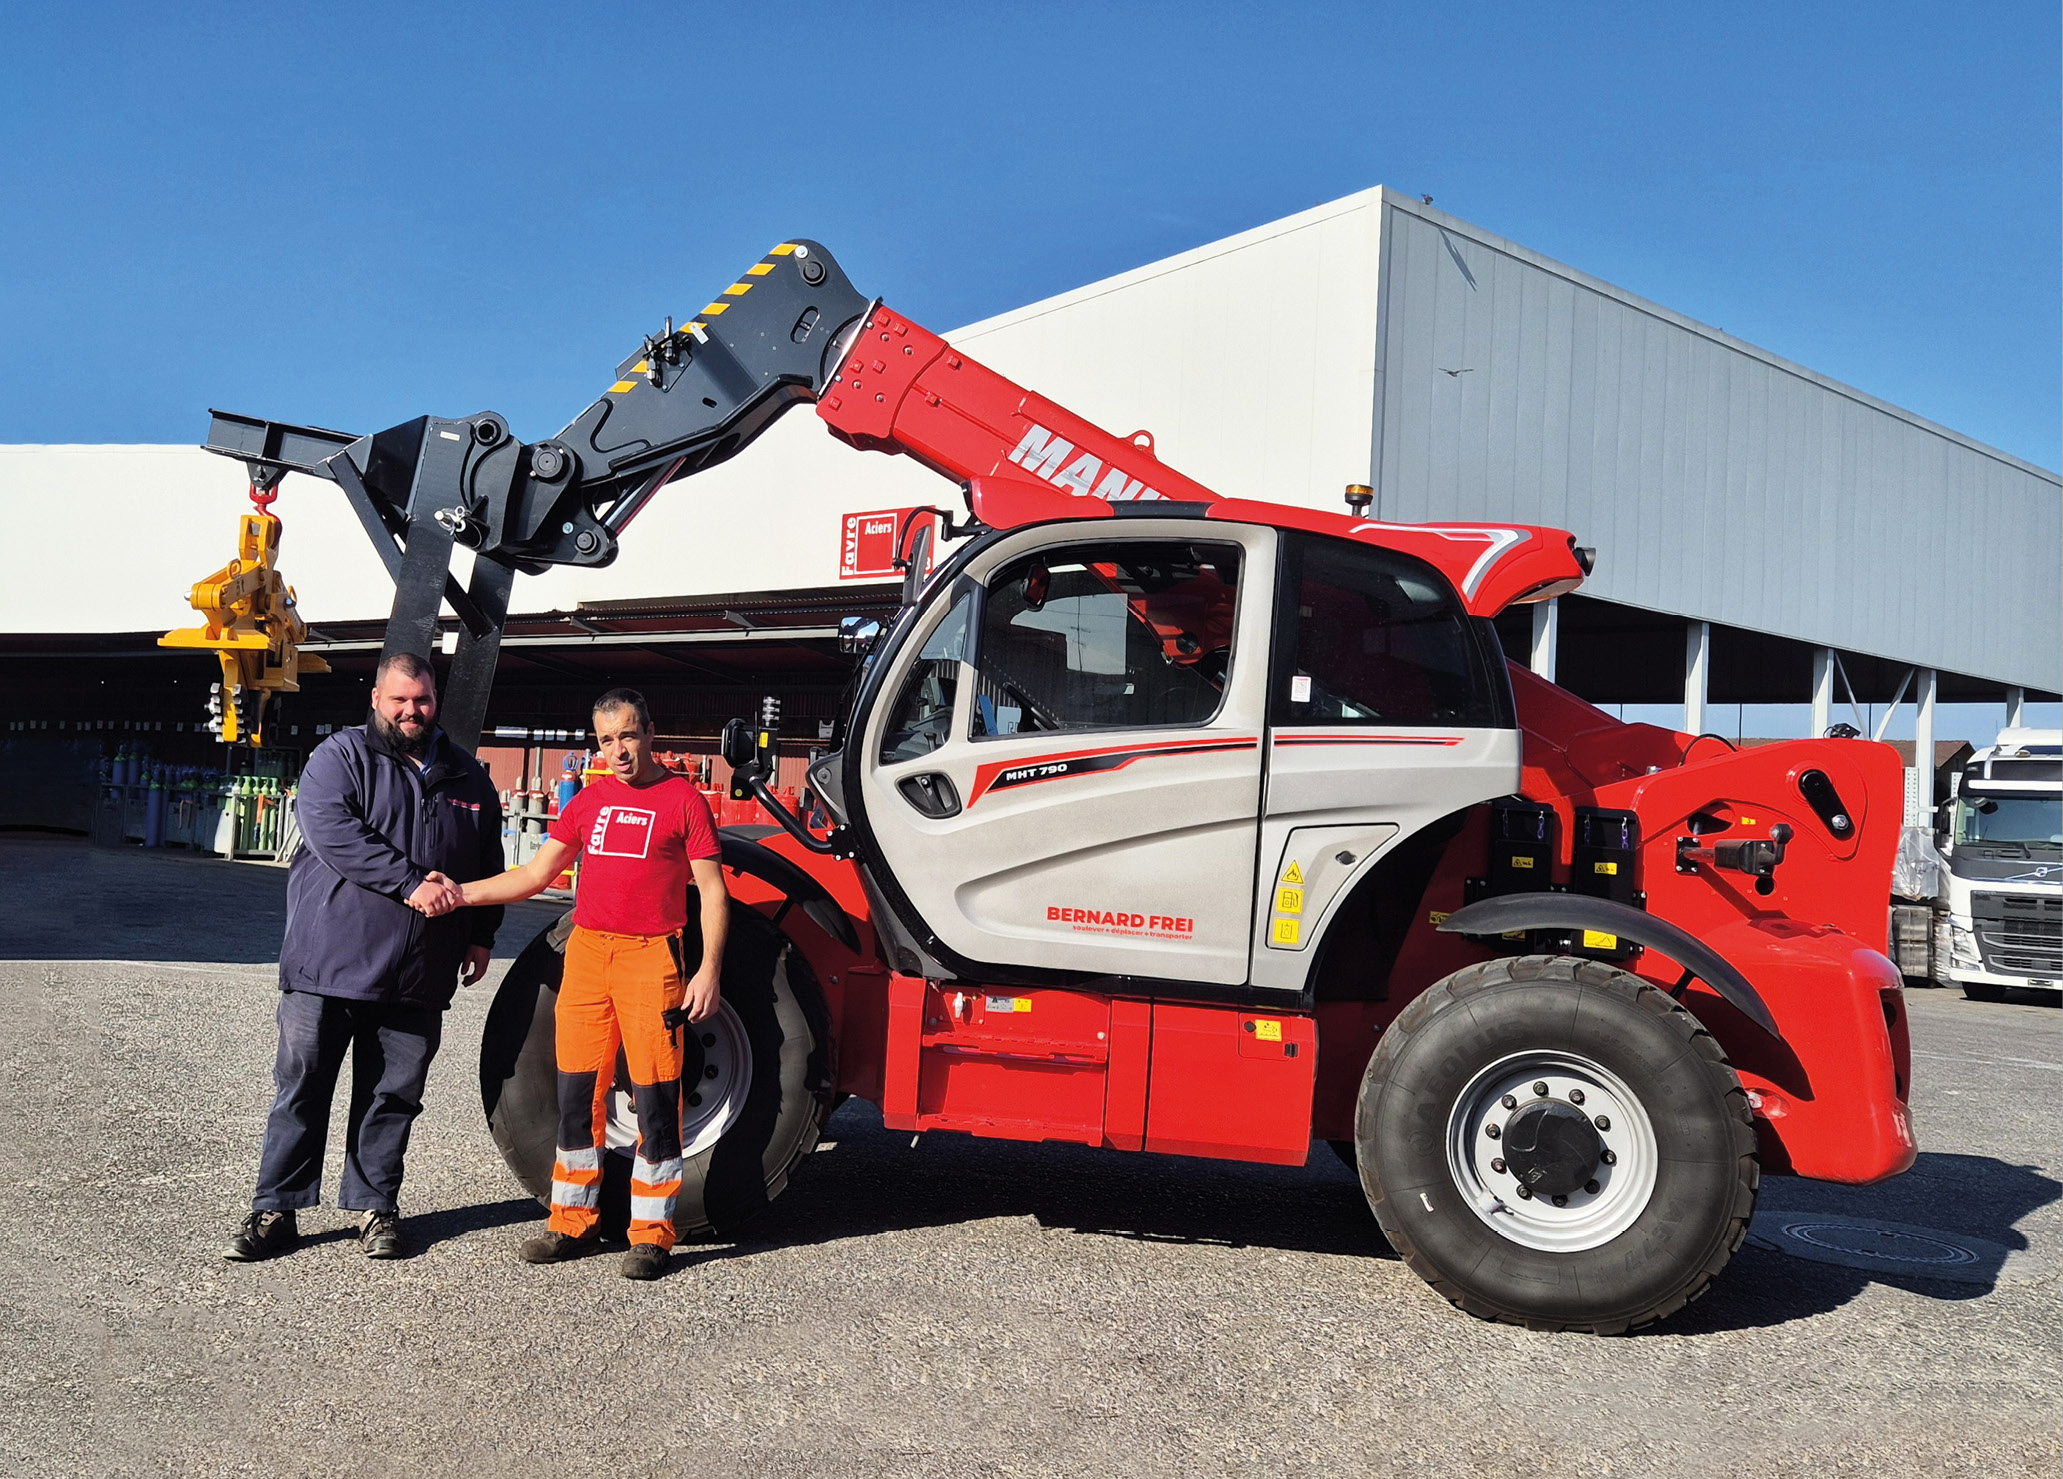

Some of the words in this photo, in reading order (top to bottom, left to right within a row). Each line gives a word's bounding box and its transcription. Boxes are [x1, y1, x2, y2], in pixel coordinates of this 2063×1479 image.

[1008, 423, 1171, 501] MAN
[864, 521, 892, 535] Aciers
[841, 517, 857, 575] Favre
[1006, 769, 1037, 781] MHT
[1039, 763, 1068, 775] 790
[616, 811, 648, 826] Aciers
[1047, 906, 1145, 928] BERNARD
[1149, 915, 1194, 933] FREI
[1072, 925, 1104, 933] soulever
[1111, 927, 1143, 937] déplacer
[1150, 931, 1193, 941] transporter
